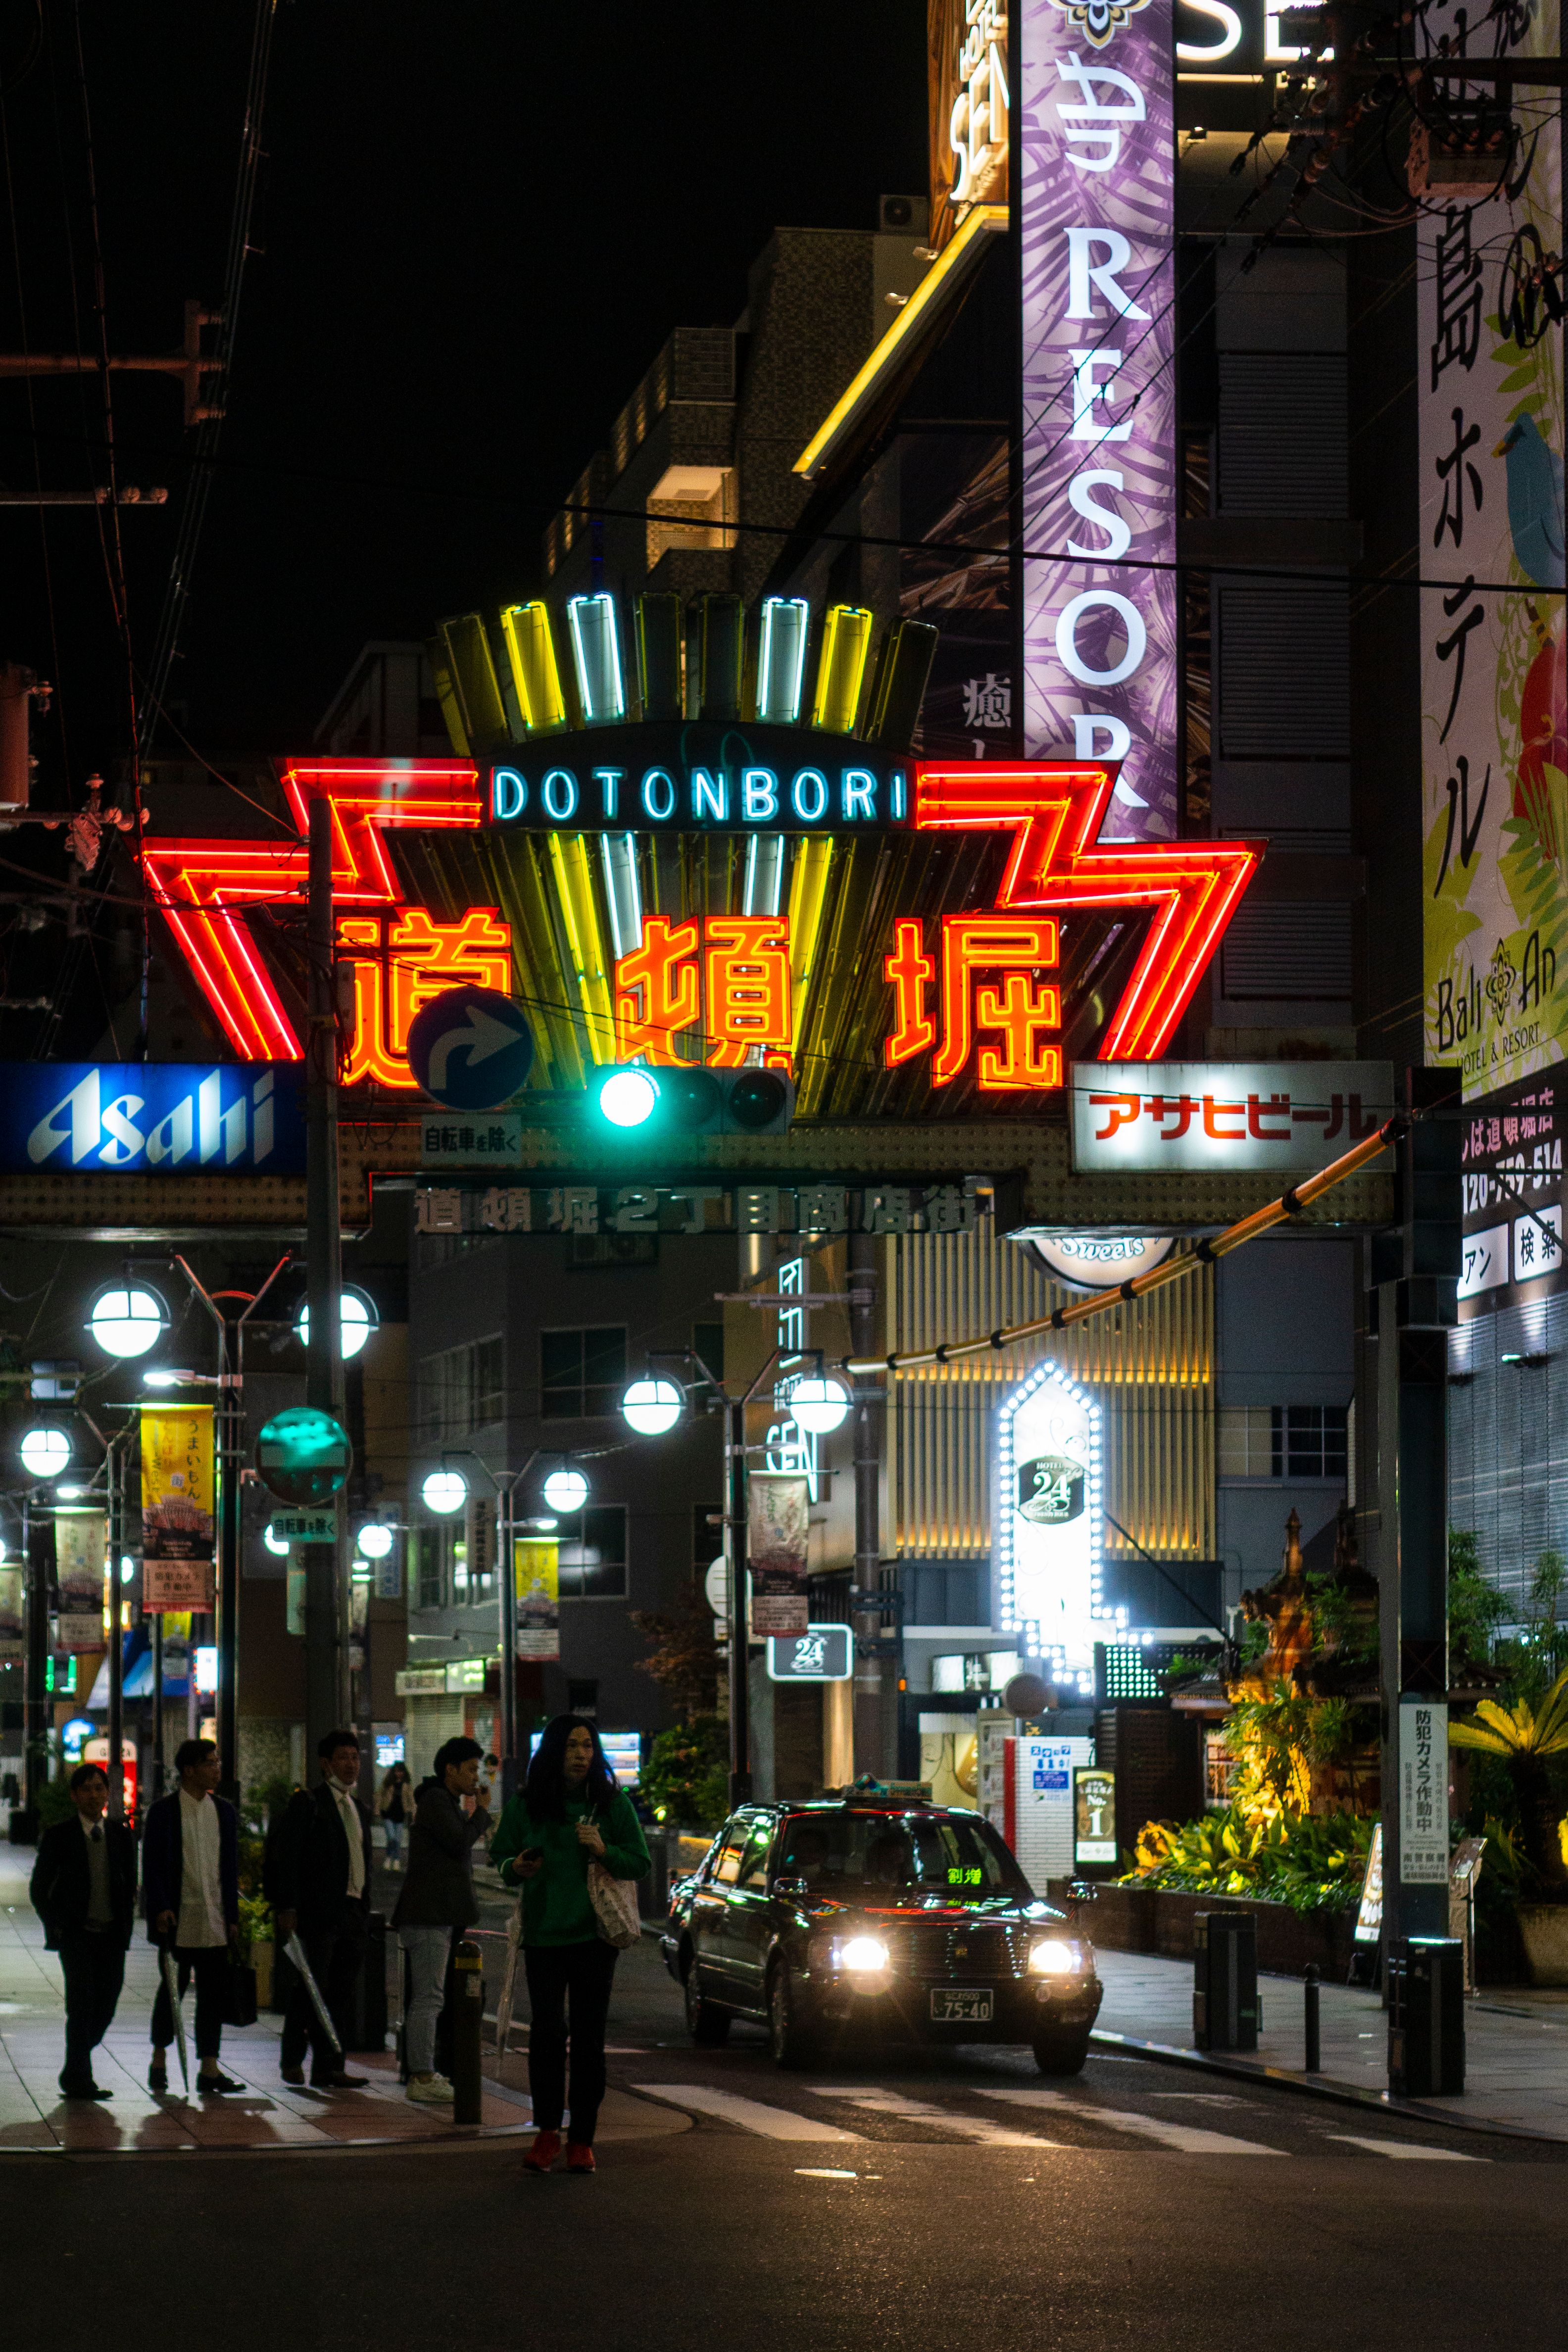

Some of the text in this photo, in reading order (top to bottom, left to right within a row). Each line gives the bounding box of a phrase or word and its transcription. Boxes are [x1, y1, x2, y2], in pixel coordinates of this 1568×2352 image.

[1054, 227, 1151, 843] RESOR
[493, 766, 908, 822] DOTONBORI
[336, 907, 1064, 1090] 道頓堀
[1435, 963, 1481, 1053] Bali
[1503, 1021, 1540, 1057] RESORT
[27, 1068, 274, 1165] Asahi
[425, 1126, 516, 1153] 自転車を除く
[1089, 1092, 1378, 1141] アサヒビール
[1461, 1087, 1554, 1162] ば道頓堀店
[1061, 1237, 1145, 1262] Sweets
[1032, 1471, 1072, 1501] 24
[794, 1637, 825, 1661] 24
[1416, 1709, 1432, 1833] 防犯カメラ作動中
[943, 2001, 989, 2019] 75-40
